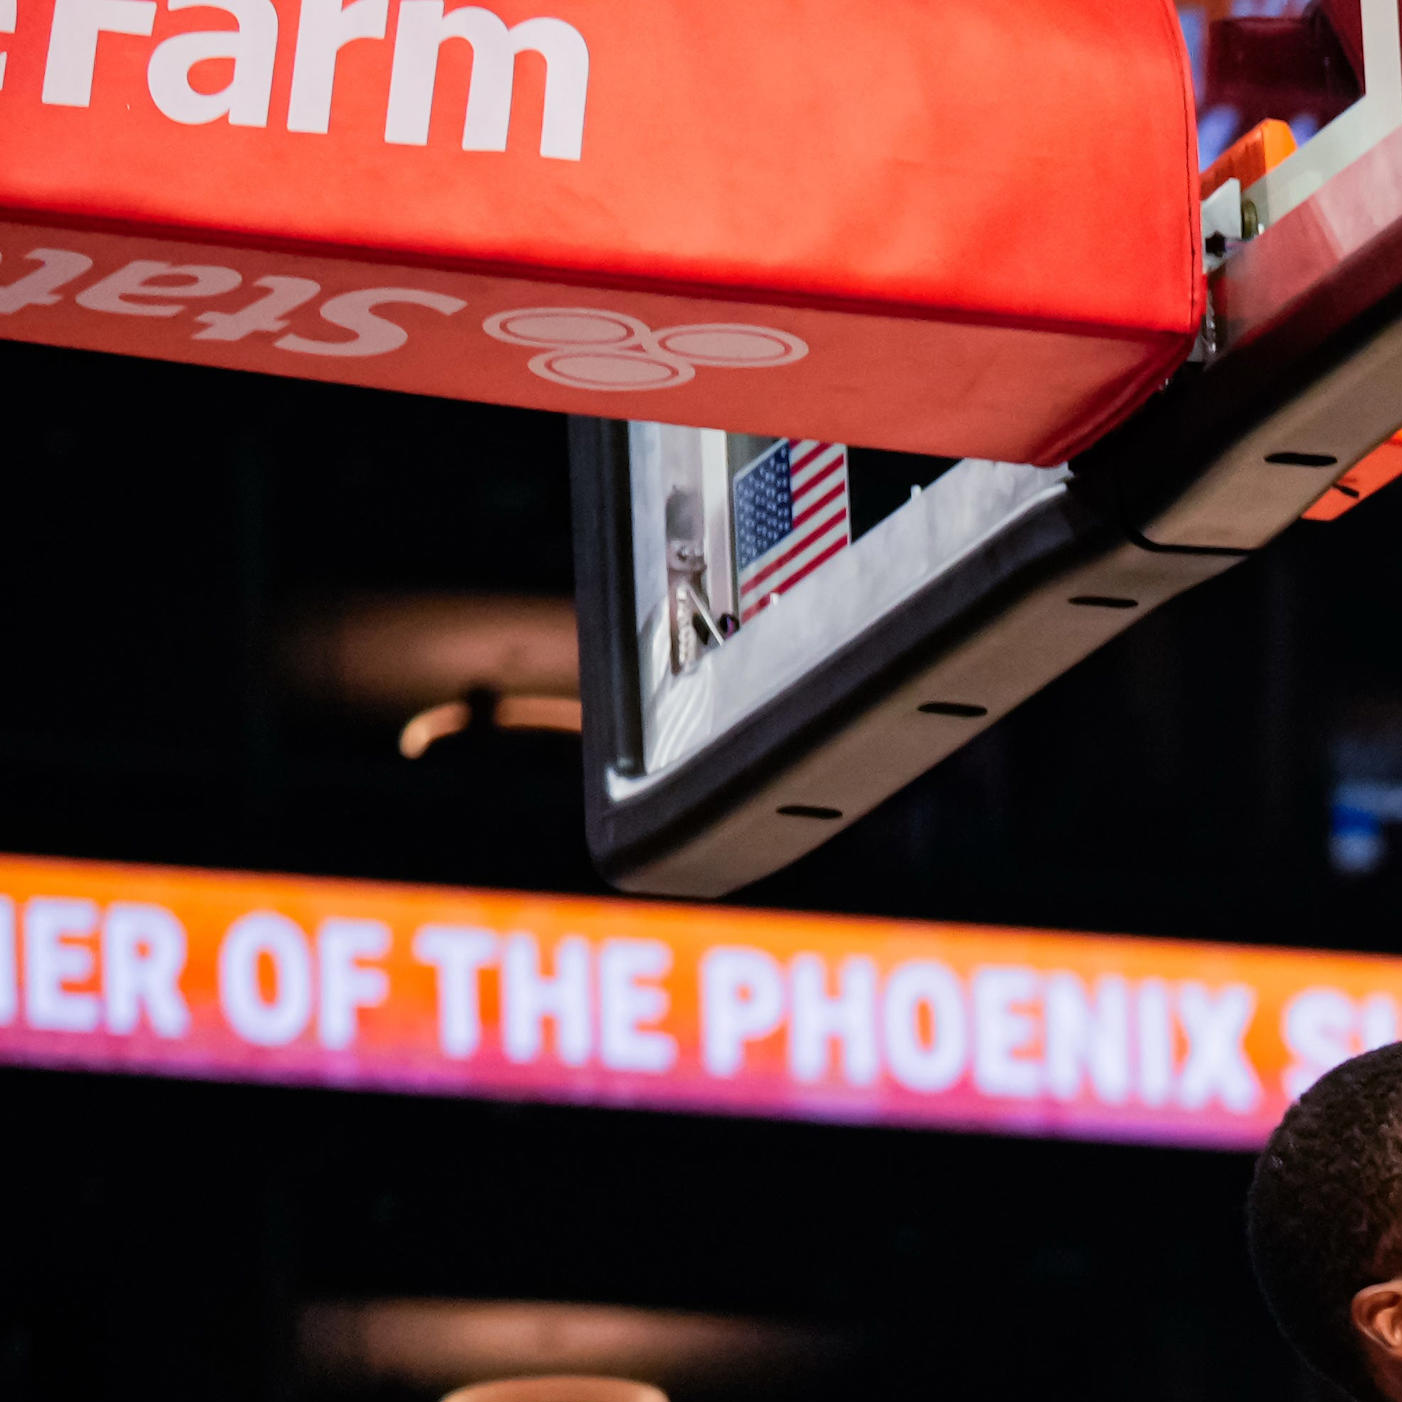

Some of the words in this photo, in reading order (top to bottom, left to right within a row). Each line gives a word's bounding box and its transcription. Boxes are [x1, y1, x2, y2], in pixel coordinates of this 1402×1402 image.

[0, 247, 468, 358] Stat
[218, 911, 392, 1052] OF
[412, 923, 678, 1074] THE
[698, 945, 1260, 1114] PHOENIX
